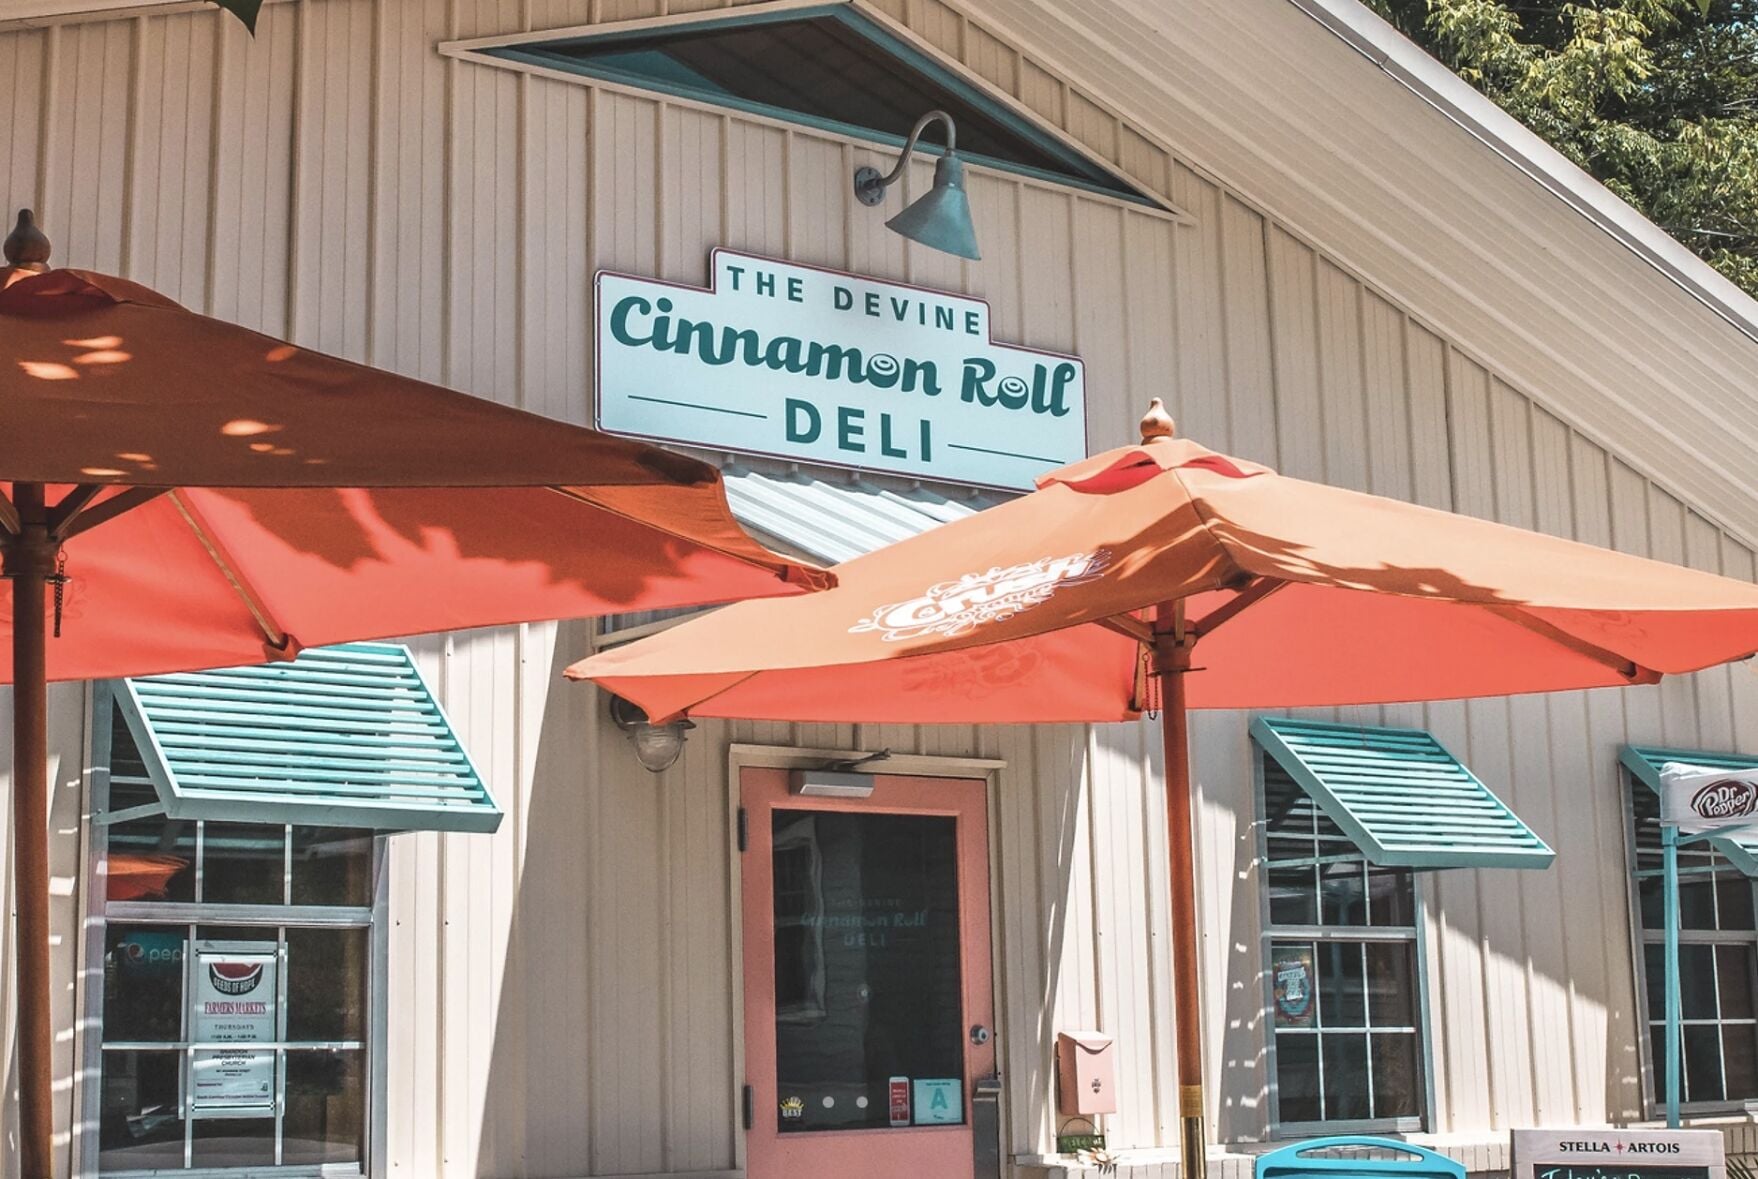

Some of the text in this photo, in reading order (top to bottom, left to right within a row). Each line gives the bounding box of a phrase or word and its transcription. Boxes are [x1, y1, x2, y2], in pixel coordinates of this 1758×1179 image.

[726, 265, 981, 335] THE DEVINE
[609, 296, 1075, 417] Cinnamon Roll
[784, 397, 933, 462] DELI
[1705, 790, 1750, 816] Pepper
[1717, 786, 1738, 801] Dr
[149, 948, 182, 964] pep
[213, 977, 256, 993] SEEDS OF HOPE
[235, 1001, 267, 1015] MARKETS
[930, 1087, 948, 1110] A
[1559, 1141, 1680, 1153] STELLA ARTOIS
